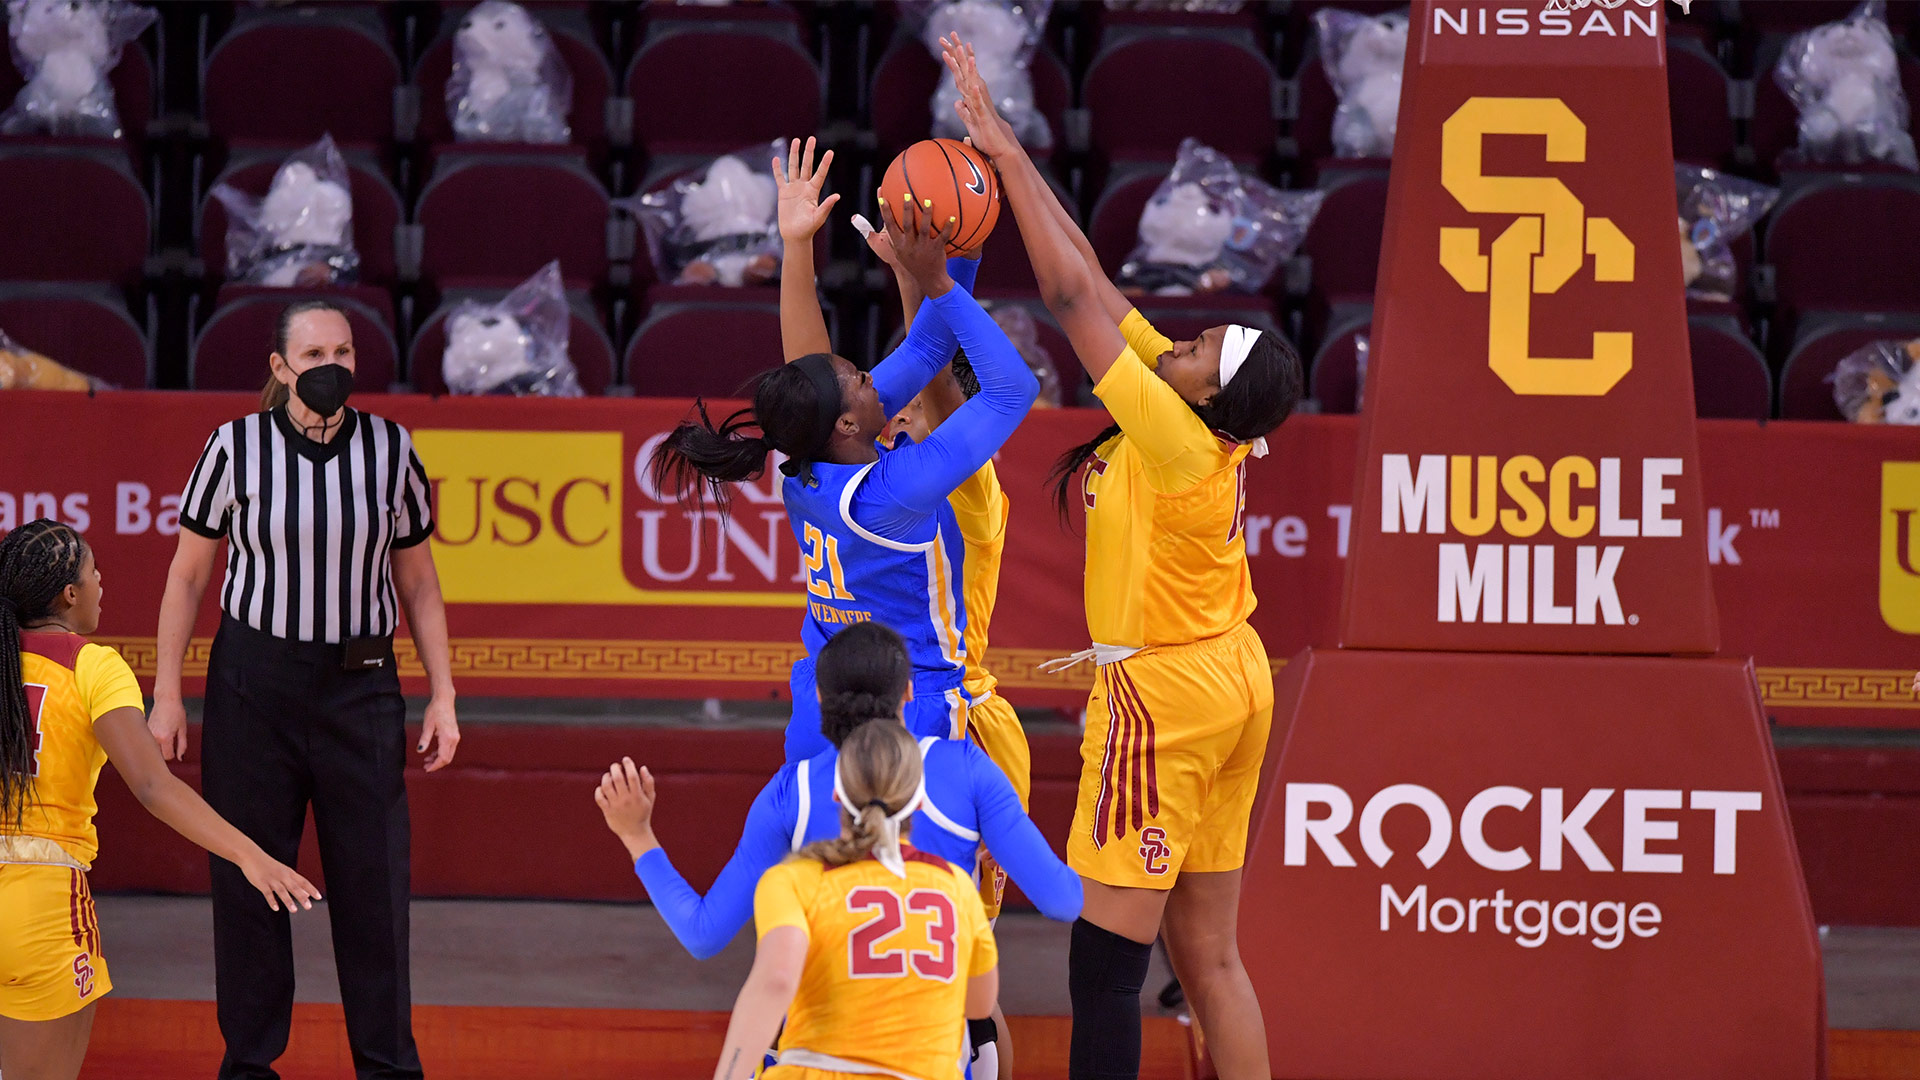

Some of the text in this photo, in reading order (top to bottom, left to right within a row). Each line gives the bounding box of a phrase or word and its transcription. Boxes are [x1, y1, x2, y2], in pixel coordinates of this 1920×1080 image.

[1433, 8, 1657, 37] NISSAN
[1439, 96, 1635, 396] SC
[427, 476, 611, 547] USC
[1381, 453, 1683, 538] MUSCLE
[803, 520, 856, 600] 21
[1284, 783, 1763, 875] ROCKET
[846, 886, 958, 983] 23
[1380, 884, 1662, 950] Mortgage
